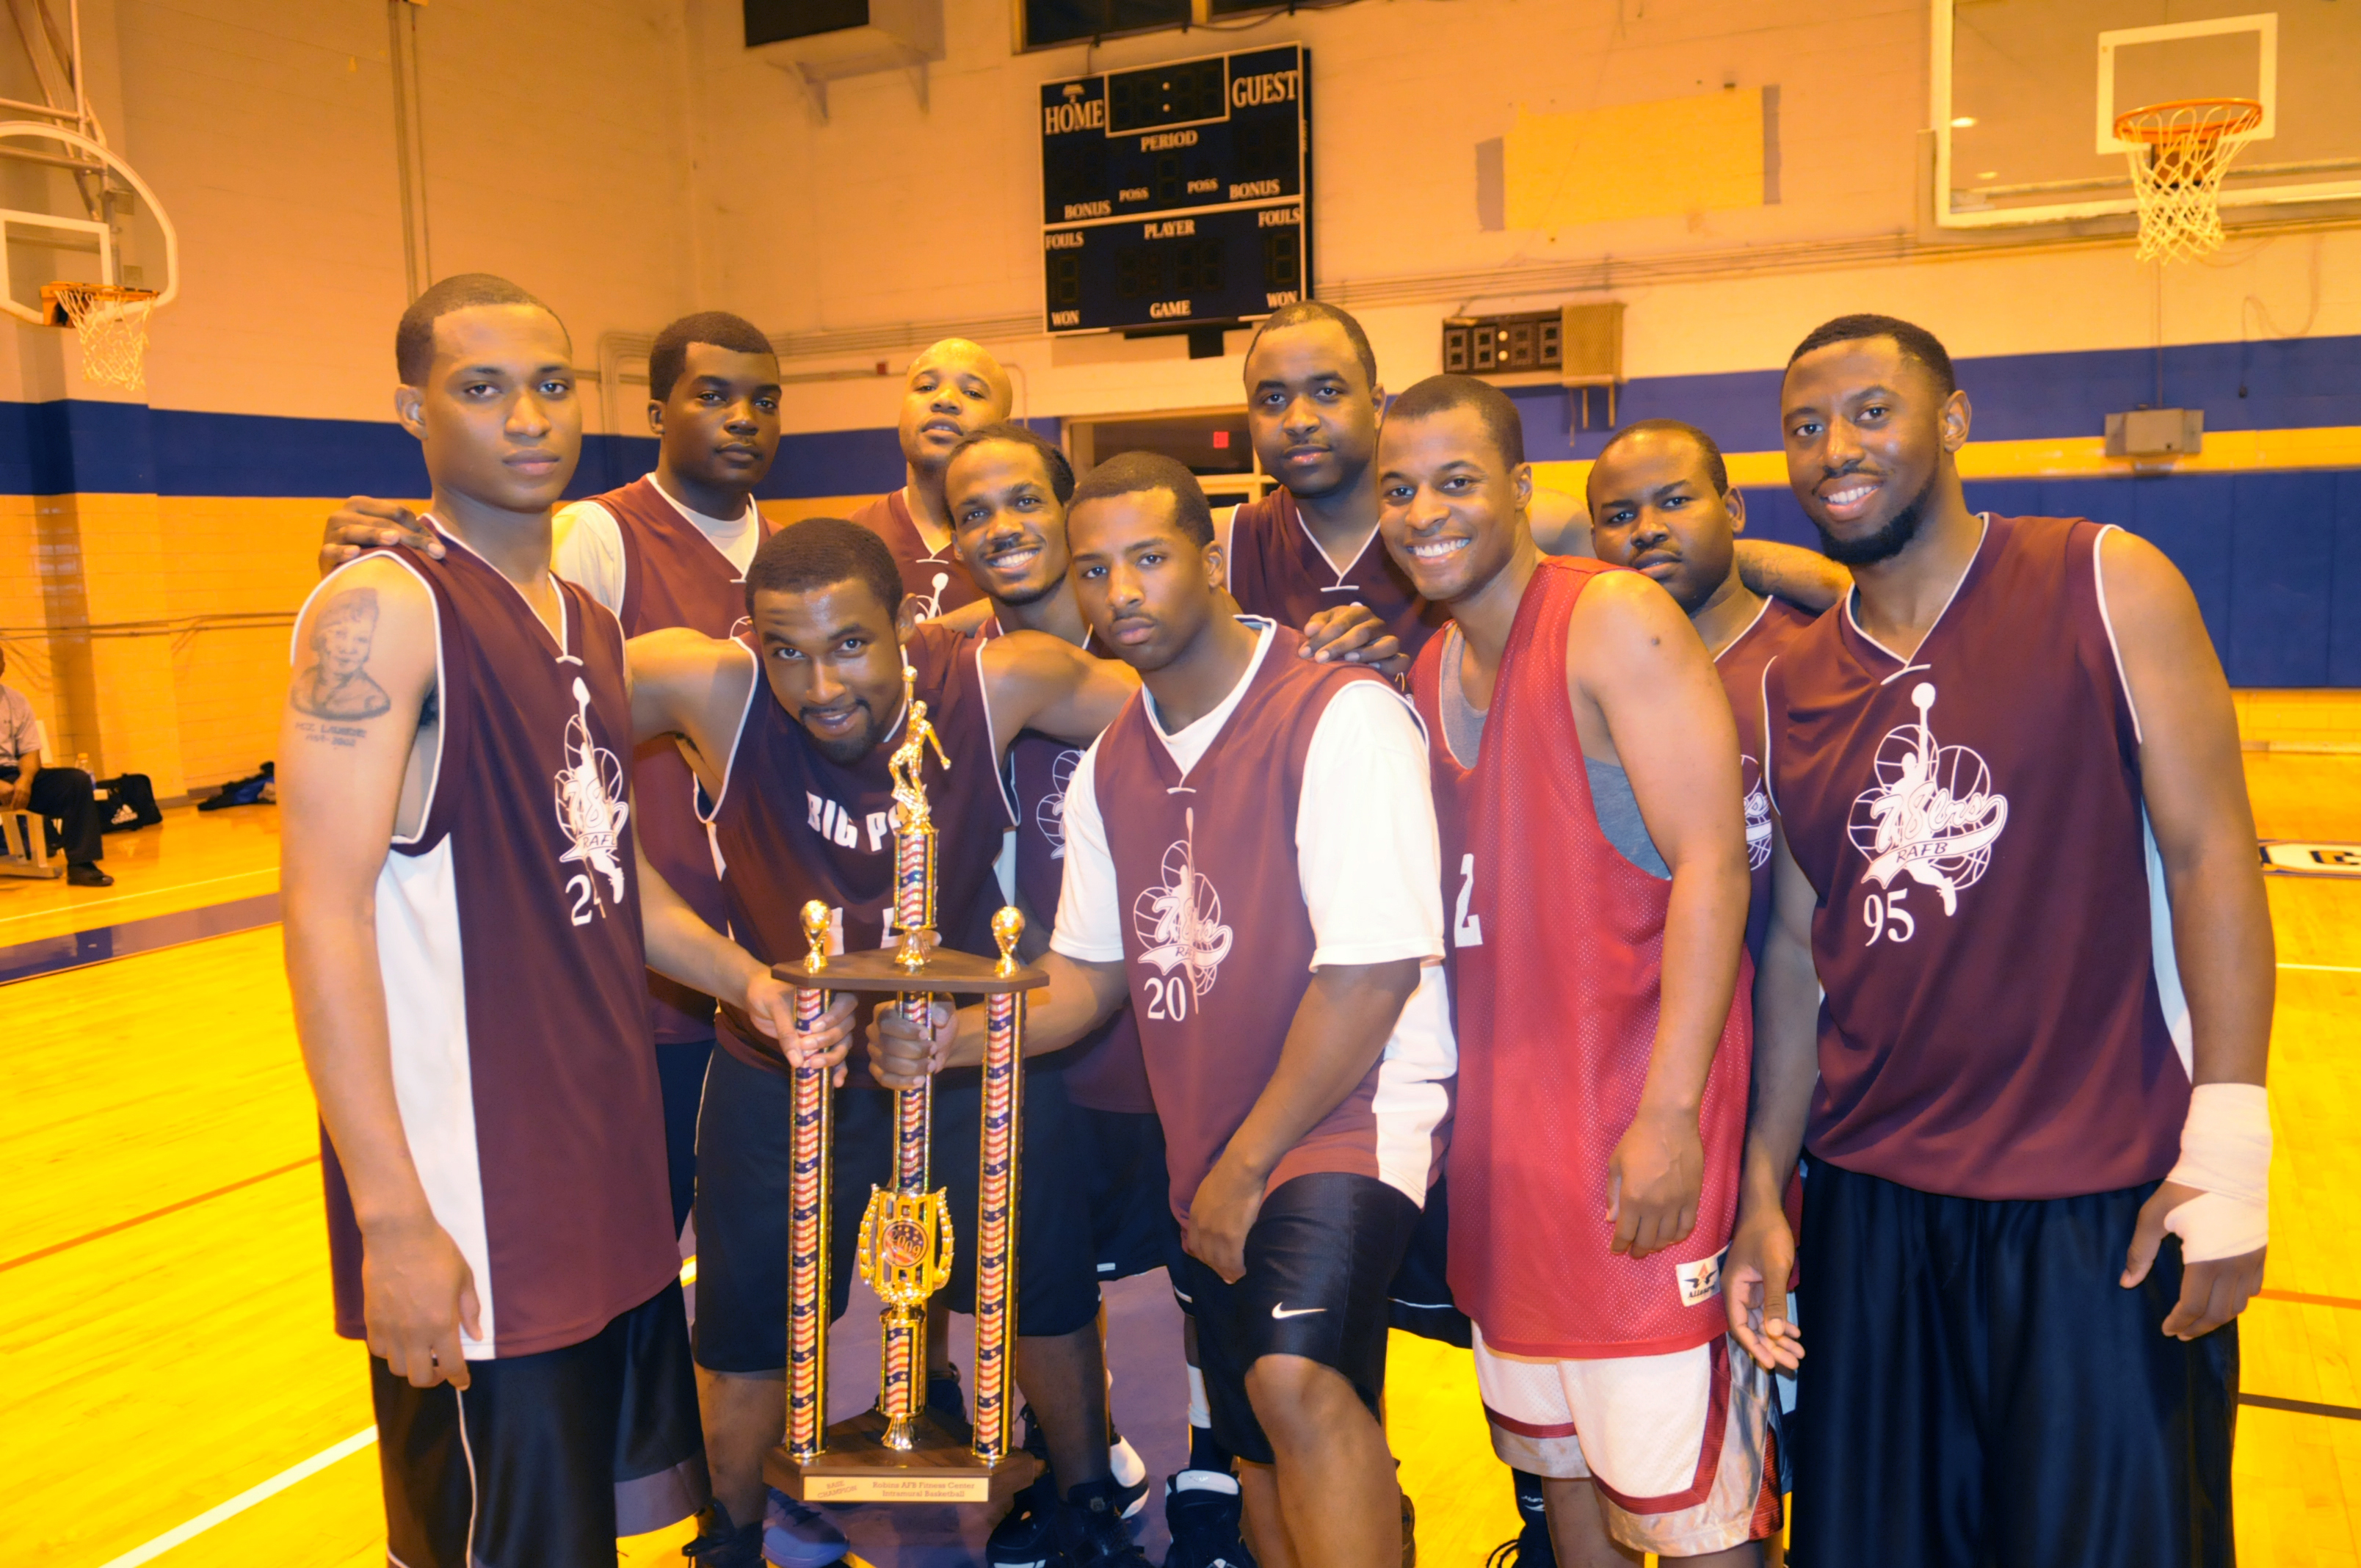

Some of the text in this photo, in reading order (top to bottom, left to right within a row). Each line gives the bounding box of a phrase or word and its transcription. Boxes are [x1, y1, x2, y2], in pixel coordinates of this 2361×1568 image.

[1232, 70, 1298, 109] GUEST
[1045, 99, 1104, 135] HOME
[1140, 129, 1198, 153] PERIOD
[1119, 187, 1150, 203] POSS
[1186, 178, 1219, 195] POSS
[1229, 178, 1280, 200] BONUS
[1065, 200, 1111, 220] BONUS
[1258, 207, 1301, 228] FOULS
[1144, 219, 1195, 241] PLAYER
[1045, 231, 1084, 251] FOULS
[1149, 299, 1192, 319] GAME
[1266, 290, 1298, 309] WON
[1051, 309, 1080, 327] WON
[806, 790, 858, 849] BIG
[1896, 841, 1948, 863] RAFB
[1863, 888, 1915, 947] 95
[1144, 976, 1186, 1021] 20
[888, 1228, 921, 1259] 2009
[817, 1485, 857, 1499] CHAMPION
[826, 1480, 845, 1489] BASE
[872, 1481, 899, 1489] Robins
[919, 1481, 946, 1489] Fitness
[948, 1481, 975, 1489] Center
